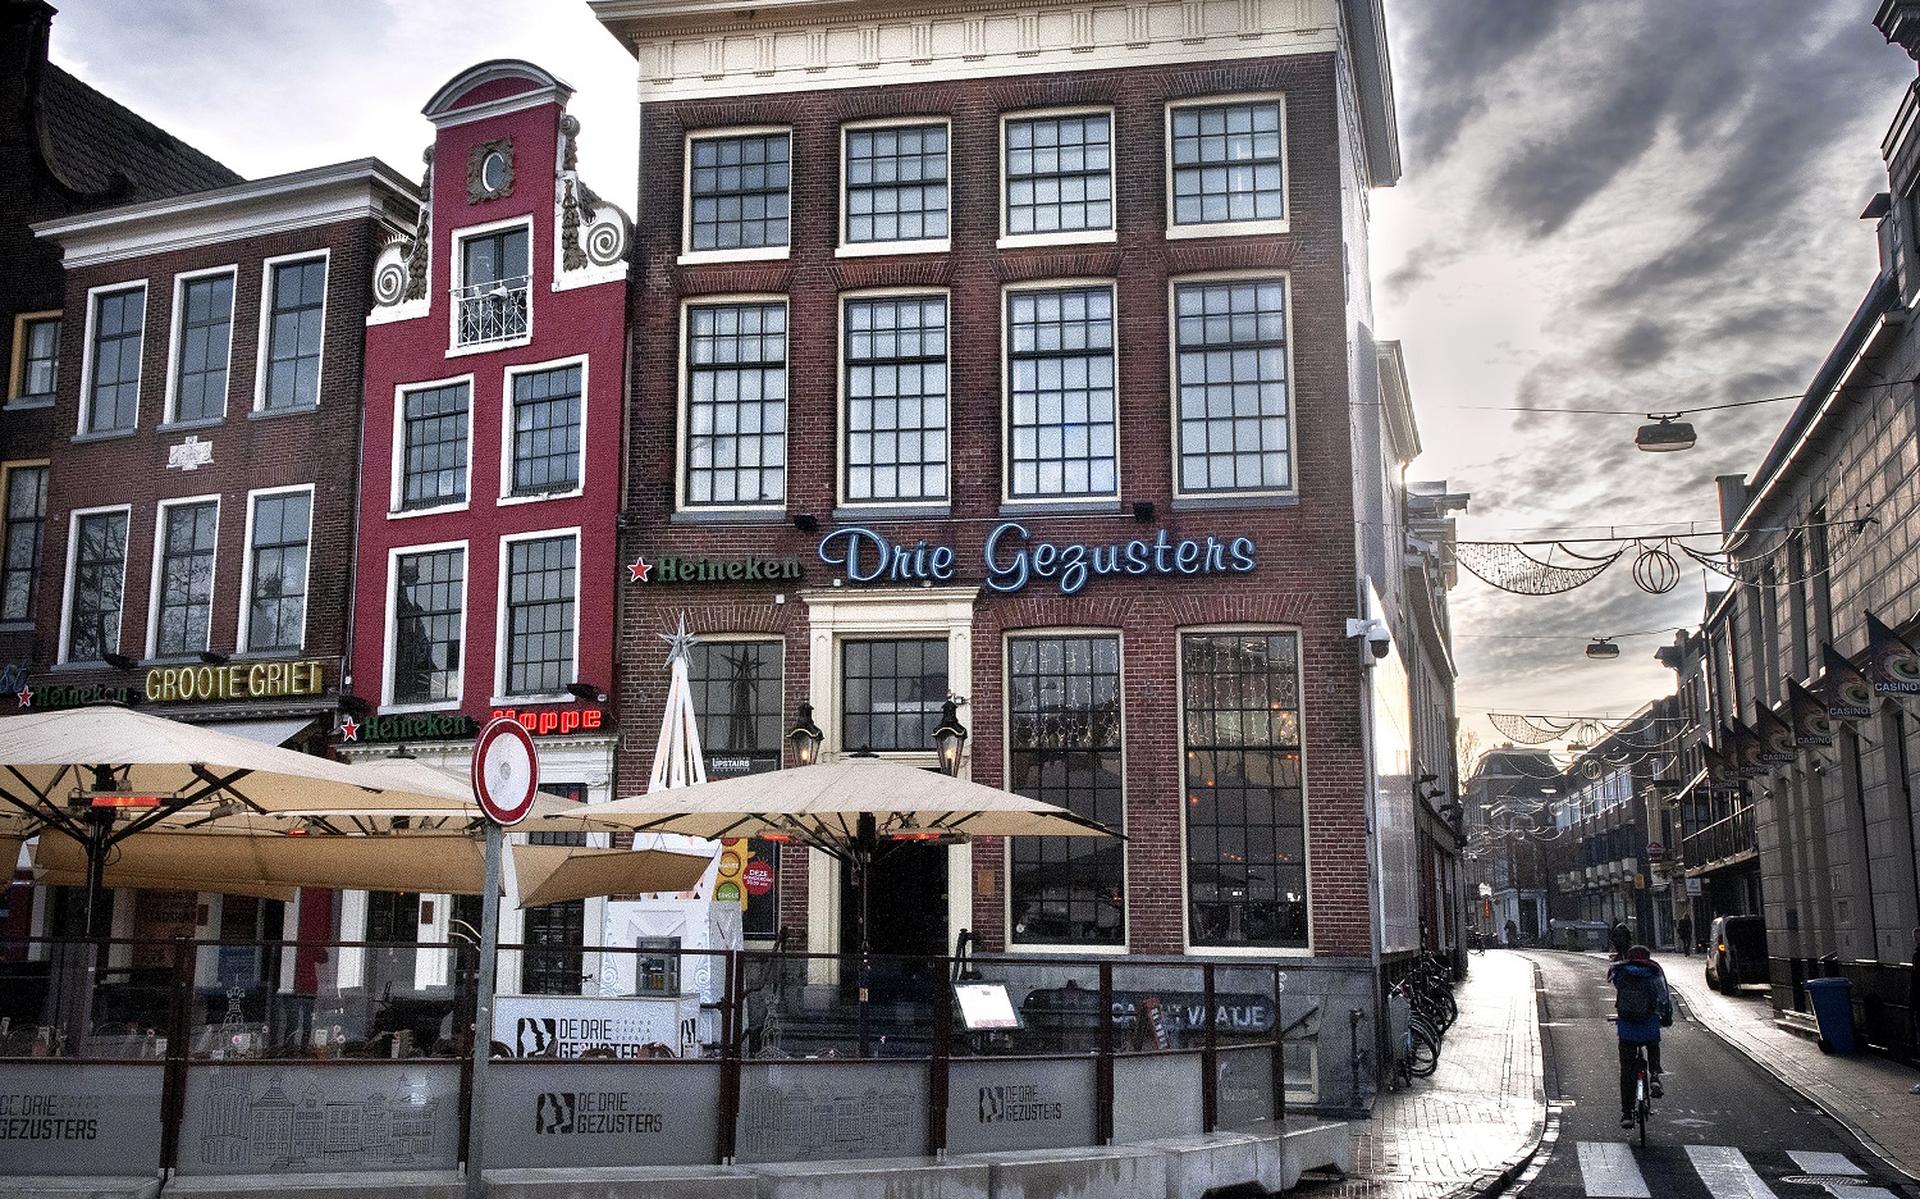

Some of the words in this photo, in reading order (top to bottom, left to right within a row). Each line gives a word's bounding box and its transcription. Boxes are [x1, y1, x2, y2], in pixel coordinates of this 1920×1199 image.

[819, 527, 955, 582] Drie
[985, 522, 1256, 593] Gezusters
[656, 555, 802, 582] Heineken
[145, 666, 242, 700] GROOTE
[249, 660, 321, 696] GRIET
[1874, 682, 1918, 692] CASINO
[1829, 706, 1870, 717] CASINO
[364, 715, 467, 740] Heineken
[1797, 736, 1831, 745] CASINO
[1762, 753, 1795, 762] CASINO
[560, 1018, 578, 1040] DE
[580, 1018, 613, 1041] DRIE
[22, 1095, 57, 1116] DRIE
[578, 1092, 597, 1112] DE
[599, 1092, 629, 1112] DRIE
[577, 1114, 663, 1134] GEZUSTERS
